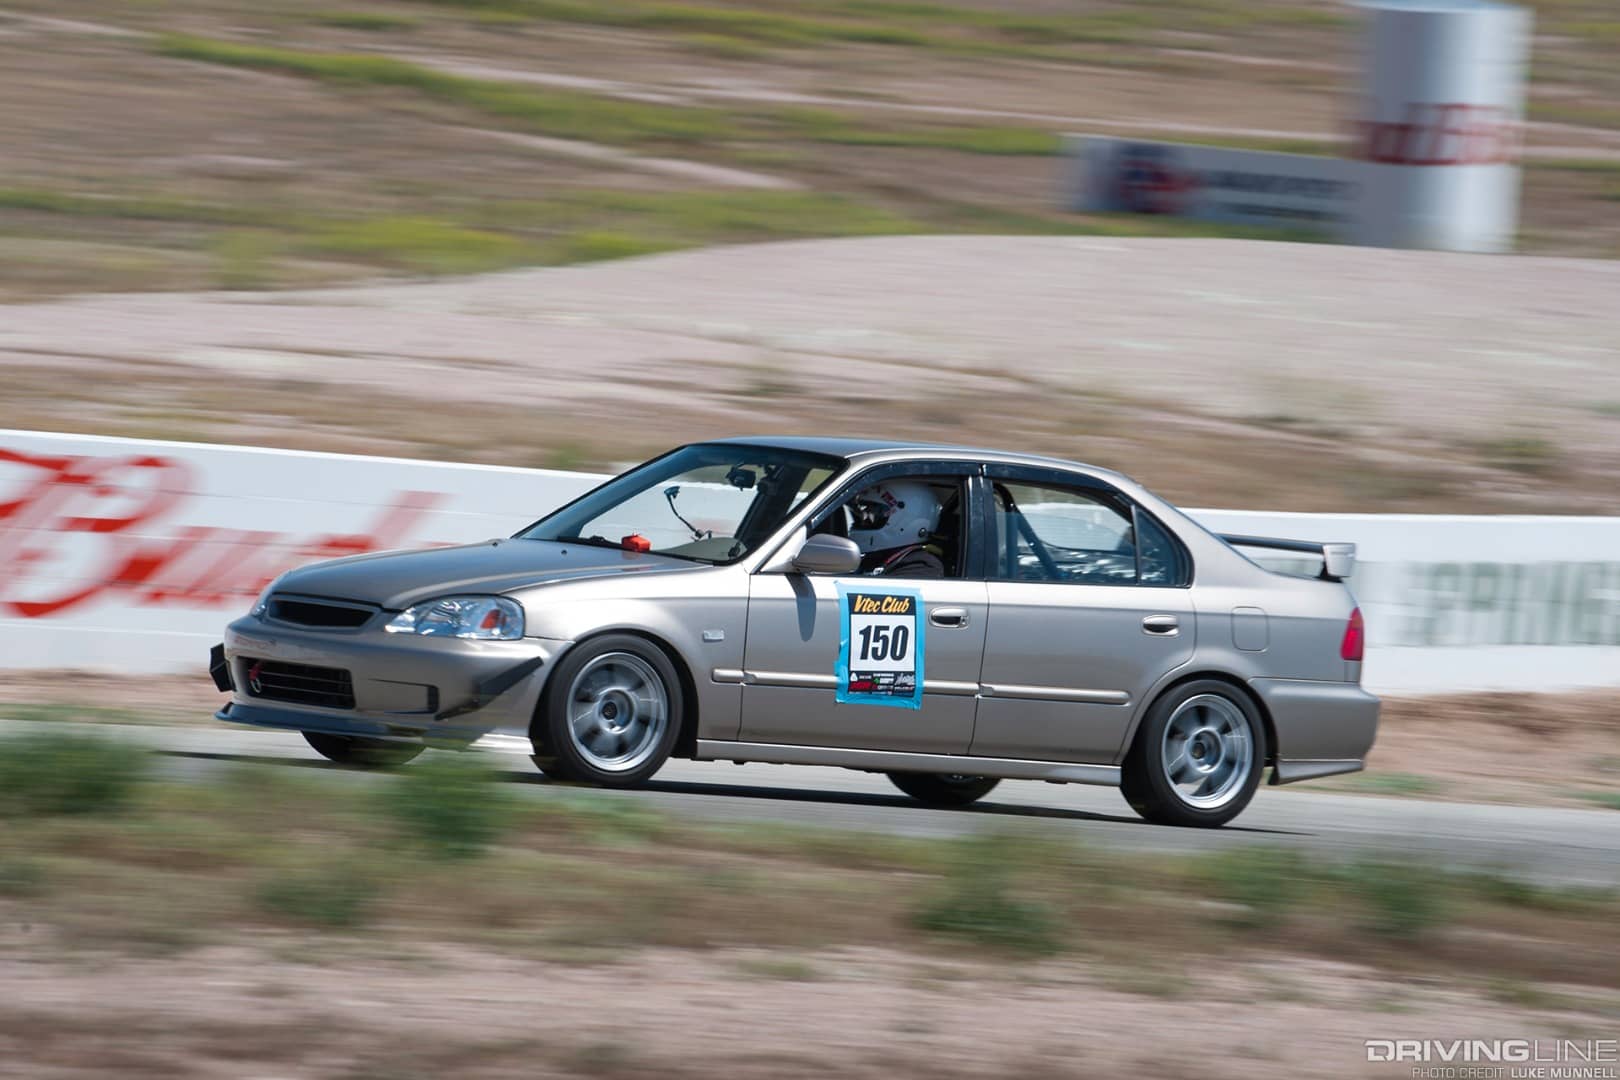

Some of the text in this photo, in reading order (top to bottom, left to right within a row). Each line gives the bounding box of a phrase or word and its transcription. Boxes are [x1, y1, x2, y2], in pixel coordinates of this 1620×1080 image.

[854, 595, 910, 613] Vtec Club
[858, 625, 909, 661] 150
